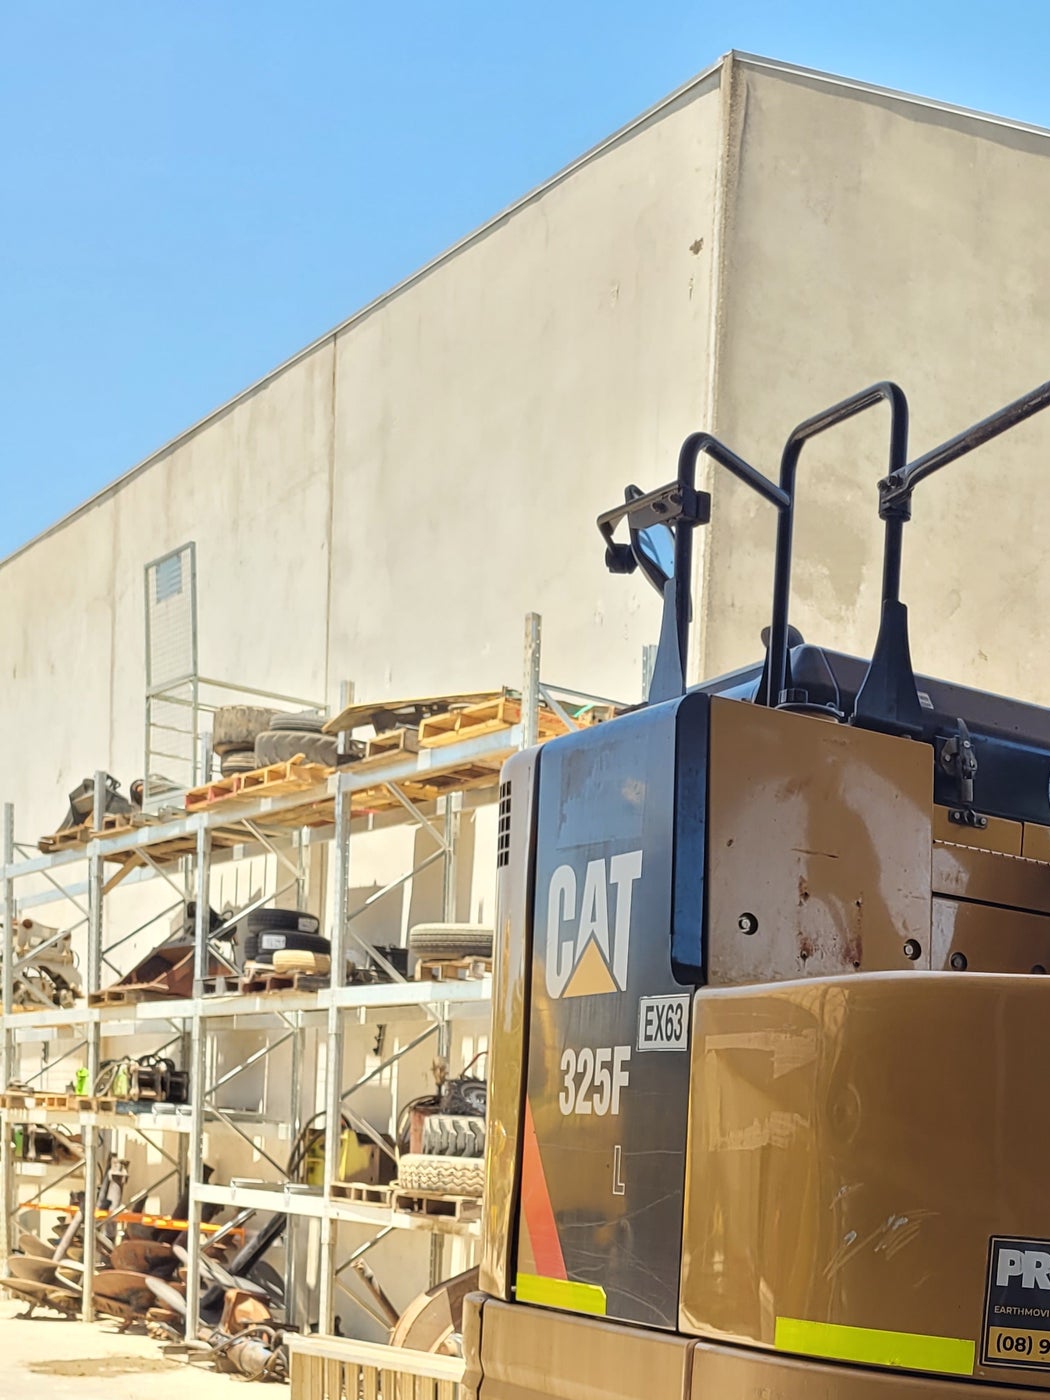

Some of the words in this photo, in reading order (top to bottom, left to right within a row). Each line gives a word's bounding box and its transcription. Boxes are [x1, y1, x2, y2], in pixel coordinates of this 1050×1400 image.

[546, 850, 643, 999] CAT
[644, 1003, 683, 1042] EX63
[559, 1046, 631, 1116] 325F
[613, 1145, 625, 1195] L
[996, 1333, 1033, 1355] (08)
